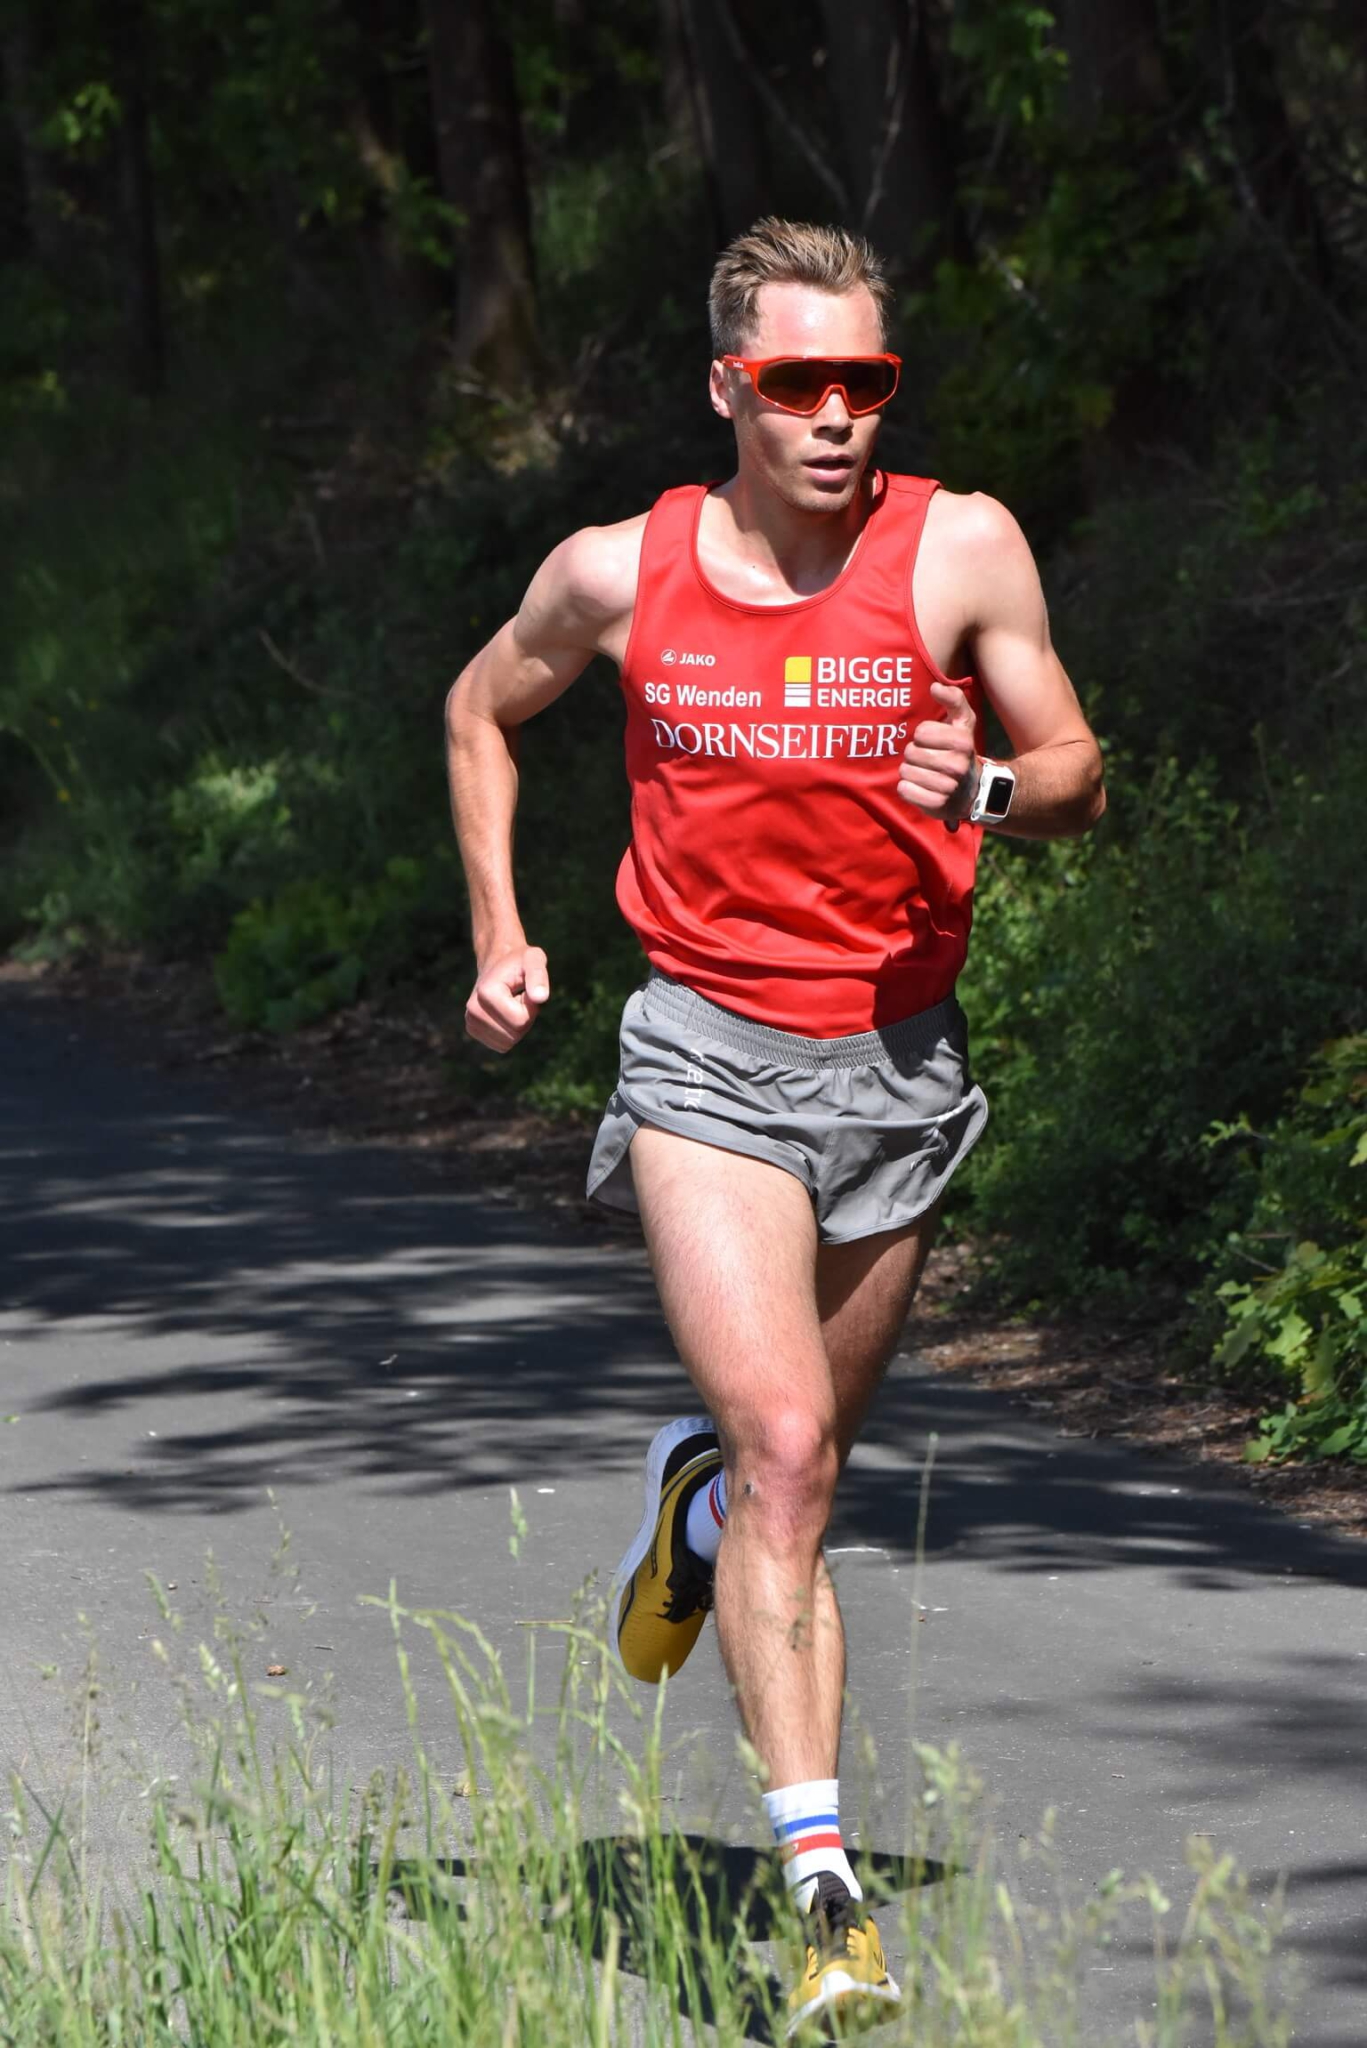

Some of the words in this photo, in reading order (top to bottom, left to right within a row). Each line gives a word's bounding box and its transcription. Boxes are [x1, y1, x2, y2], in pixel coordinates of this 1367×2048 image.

[679, 653, 716, 667] JAKO
[817, 656, 913, 684] BIGGE
[644, 682, 671, 705] SG
[676, 684, 762, 707] Wenden
[817, 688, 911, 708] ENERGIE
